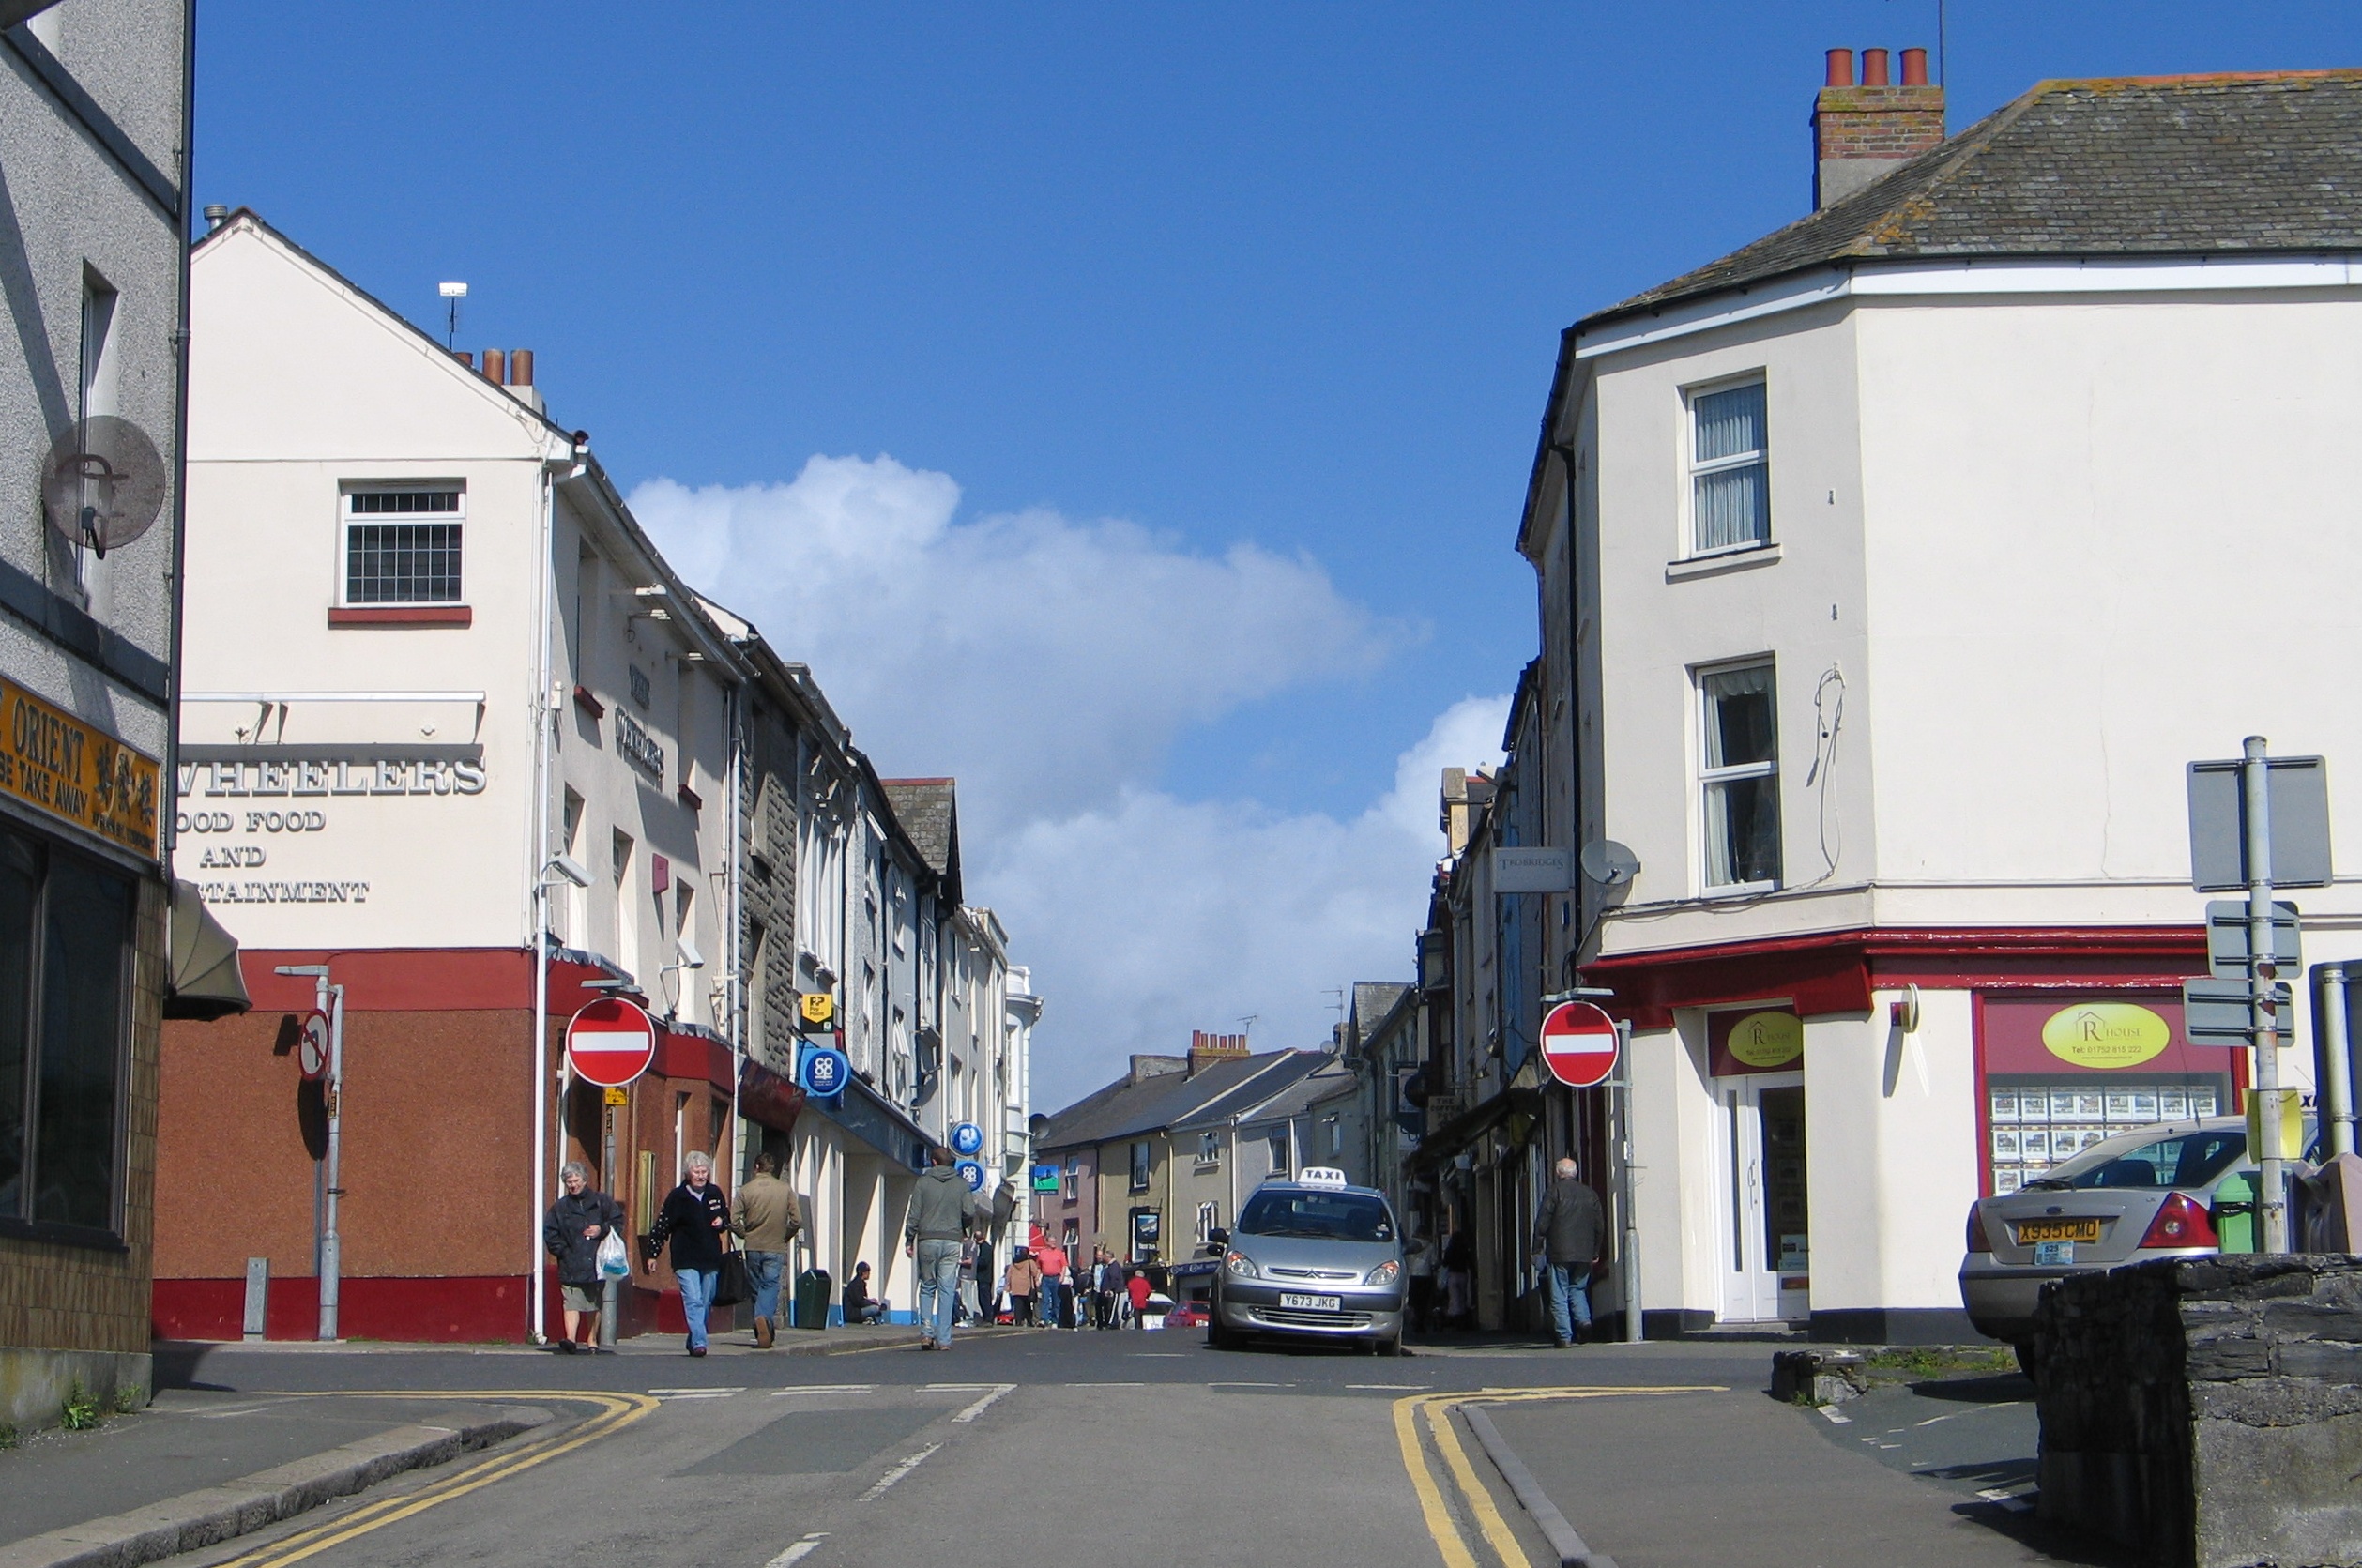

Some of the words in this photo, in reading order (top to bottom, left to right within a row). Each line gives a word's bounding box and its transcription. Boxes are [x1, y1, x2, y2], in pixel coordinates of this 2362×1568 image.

[13, 696, 84, 785] ORIENT
[18, 760, 50, 804] TAKE
[54, 779, 88, 822] AWAY
[246, 811, 327, 833] FOOD
[200, 846, 267, 868] AND
[2106, 1028, 2142, 1037] HOUSE
[1305, 1169, 1341, 1180] TAXI
[2021, 1222, 2062, 1240] X935
[1286, 1295, 1313, 1307] Y673
[1315, 1297, 1336, 1309] JKG
